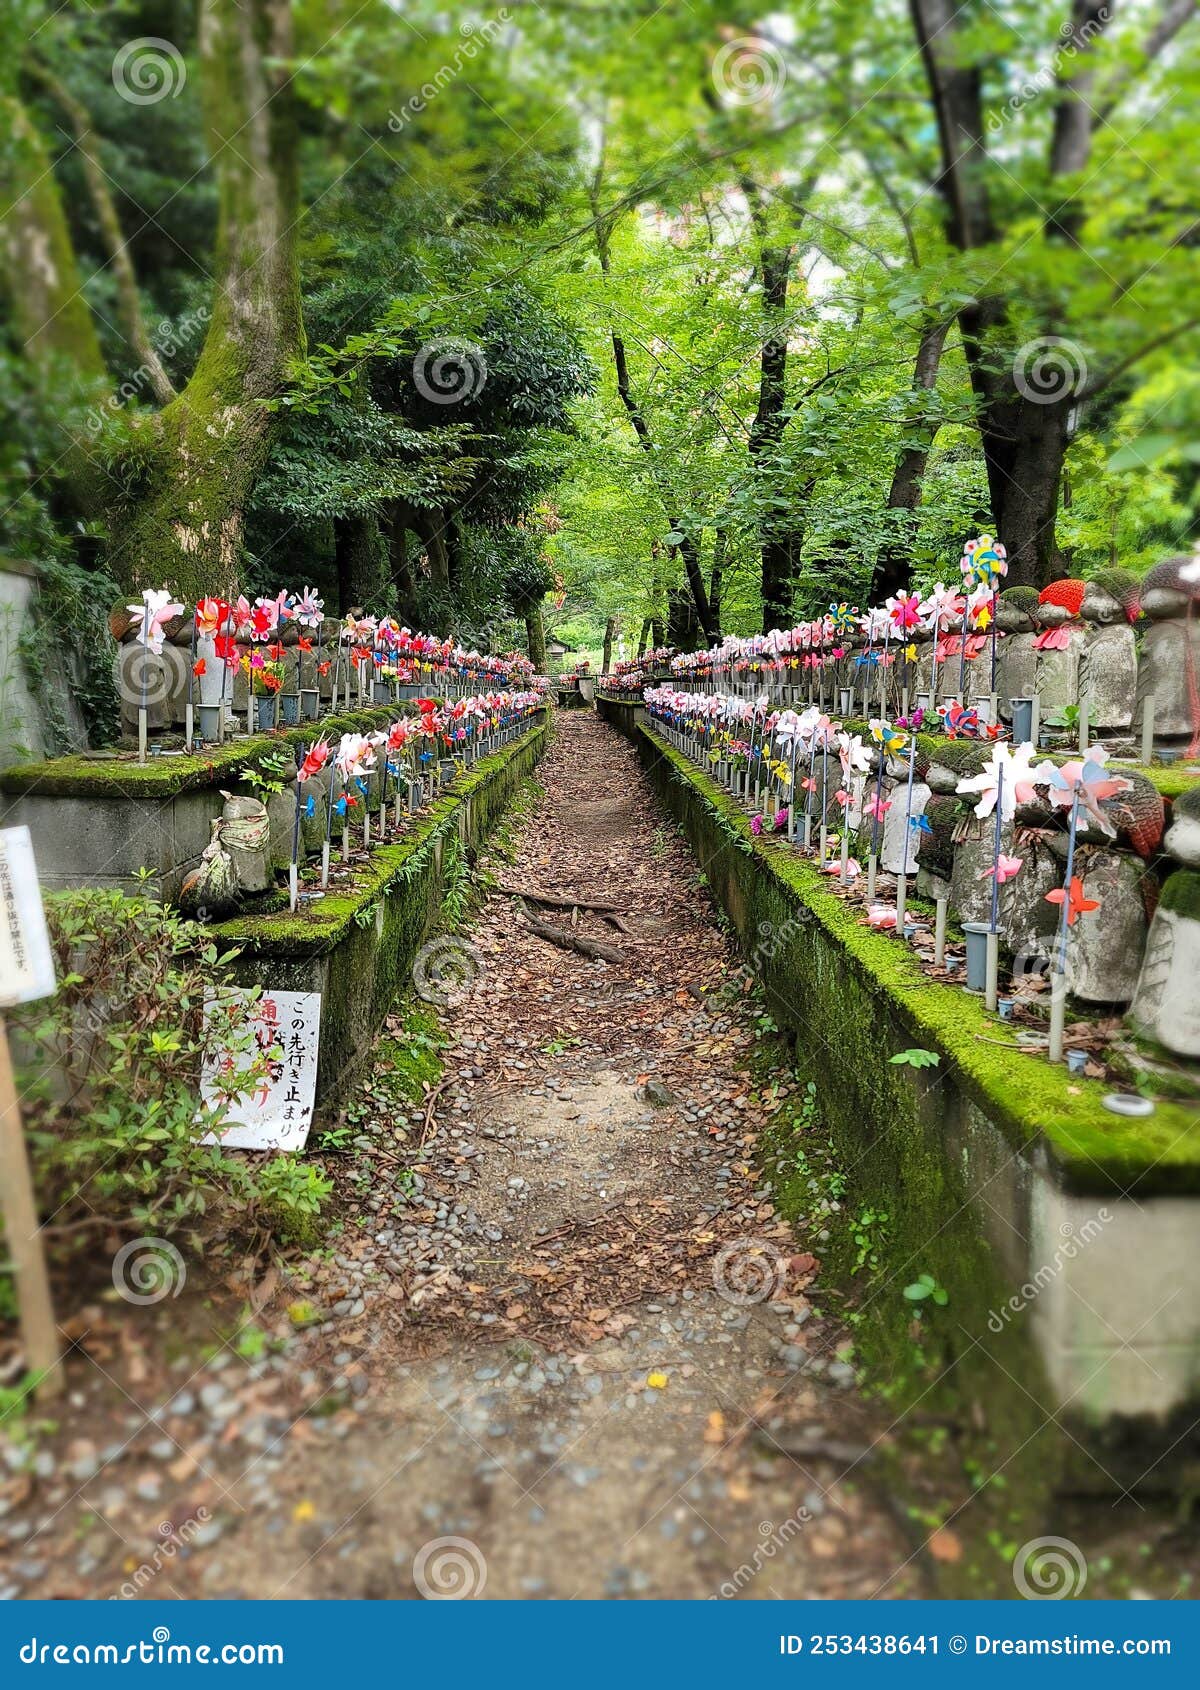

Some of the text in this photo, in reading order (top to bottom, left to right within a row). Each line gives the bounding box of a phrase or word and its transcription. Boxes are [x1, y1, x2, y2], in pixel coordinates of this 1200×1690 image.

[281, 1001, 306, 1137] この先行き止まり
